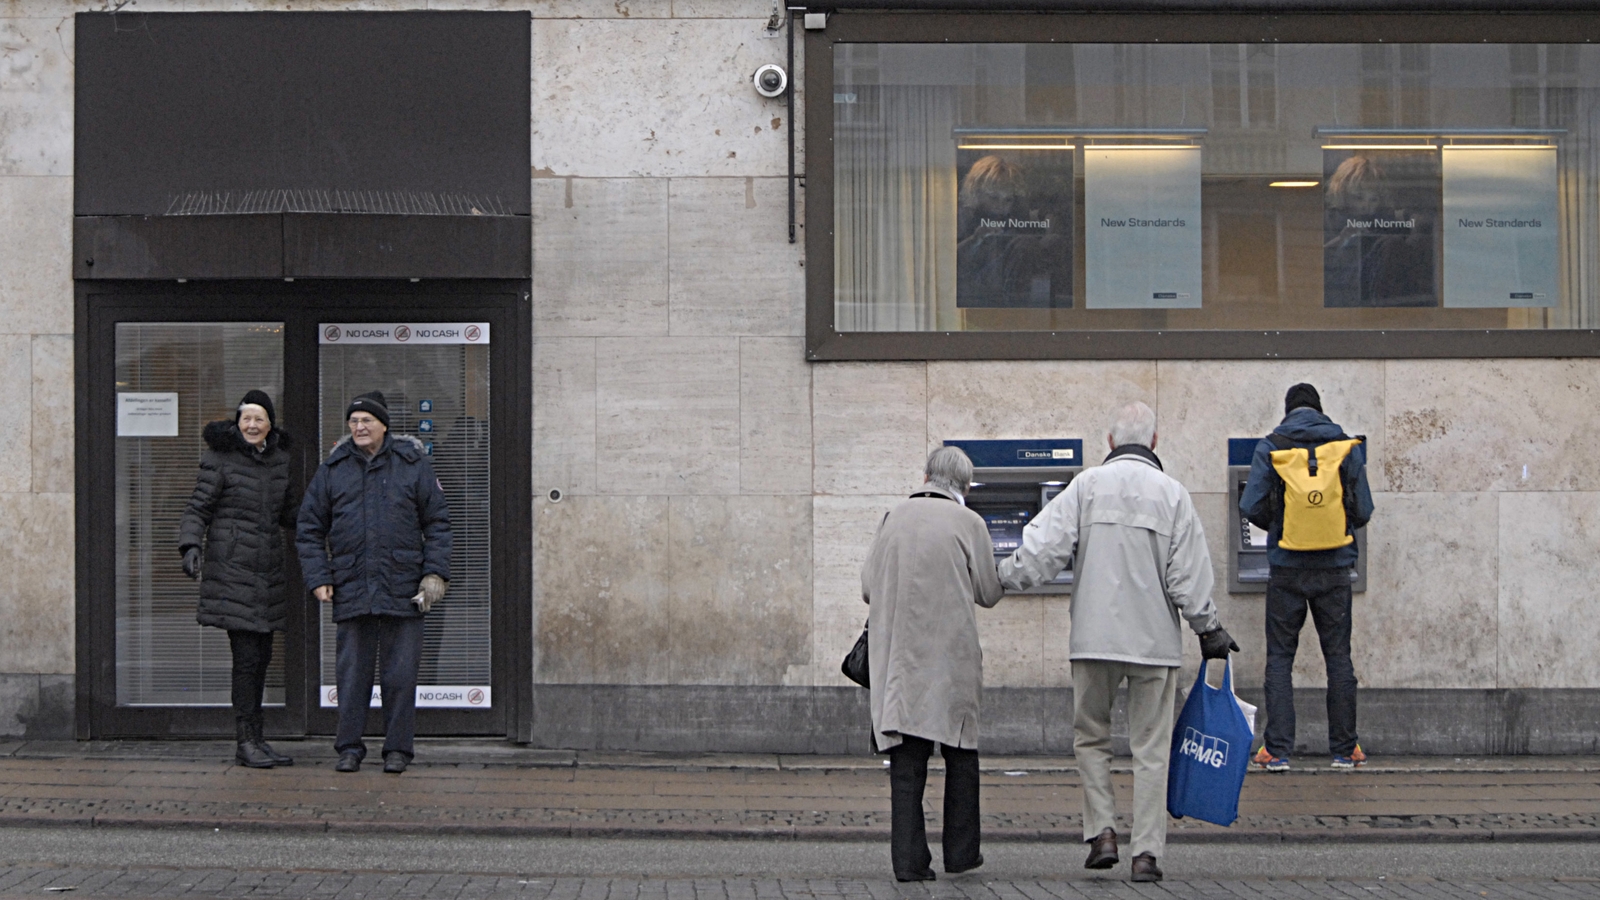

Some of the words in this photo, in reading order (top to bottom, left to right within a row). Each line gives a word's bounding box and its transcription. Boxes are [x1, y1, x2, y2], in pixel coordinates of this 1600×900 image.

[980, 217, 1006, 228] New
[1008, 217, 1050, 228] Normal
[1101, 217, 1126, 227] New
[1128, 217, 1186, 227] Standards
[1346, 218, 1371, 228] New
[1374, 218, 1415, 228] Normal
[1458, 218, 1482, 228] New
[1485, 218, 1542, 228] Standards
[1179, 738, 1224, 768] KPMG
